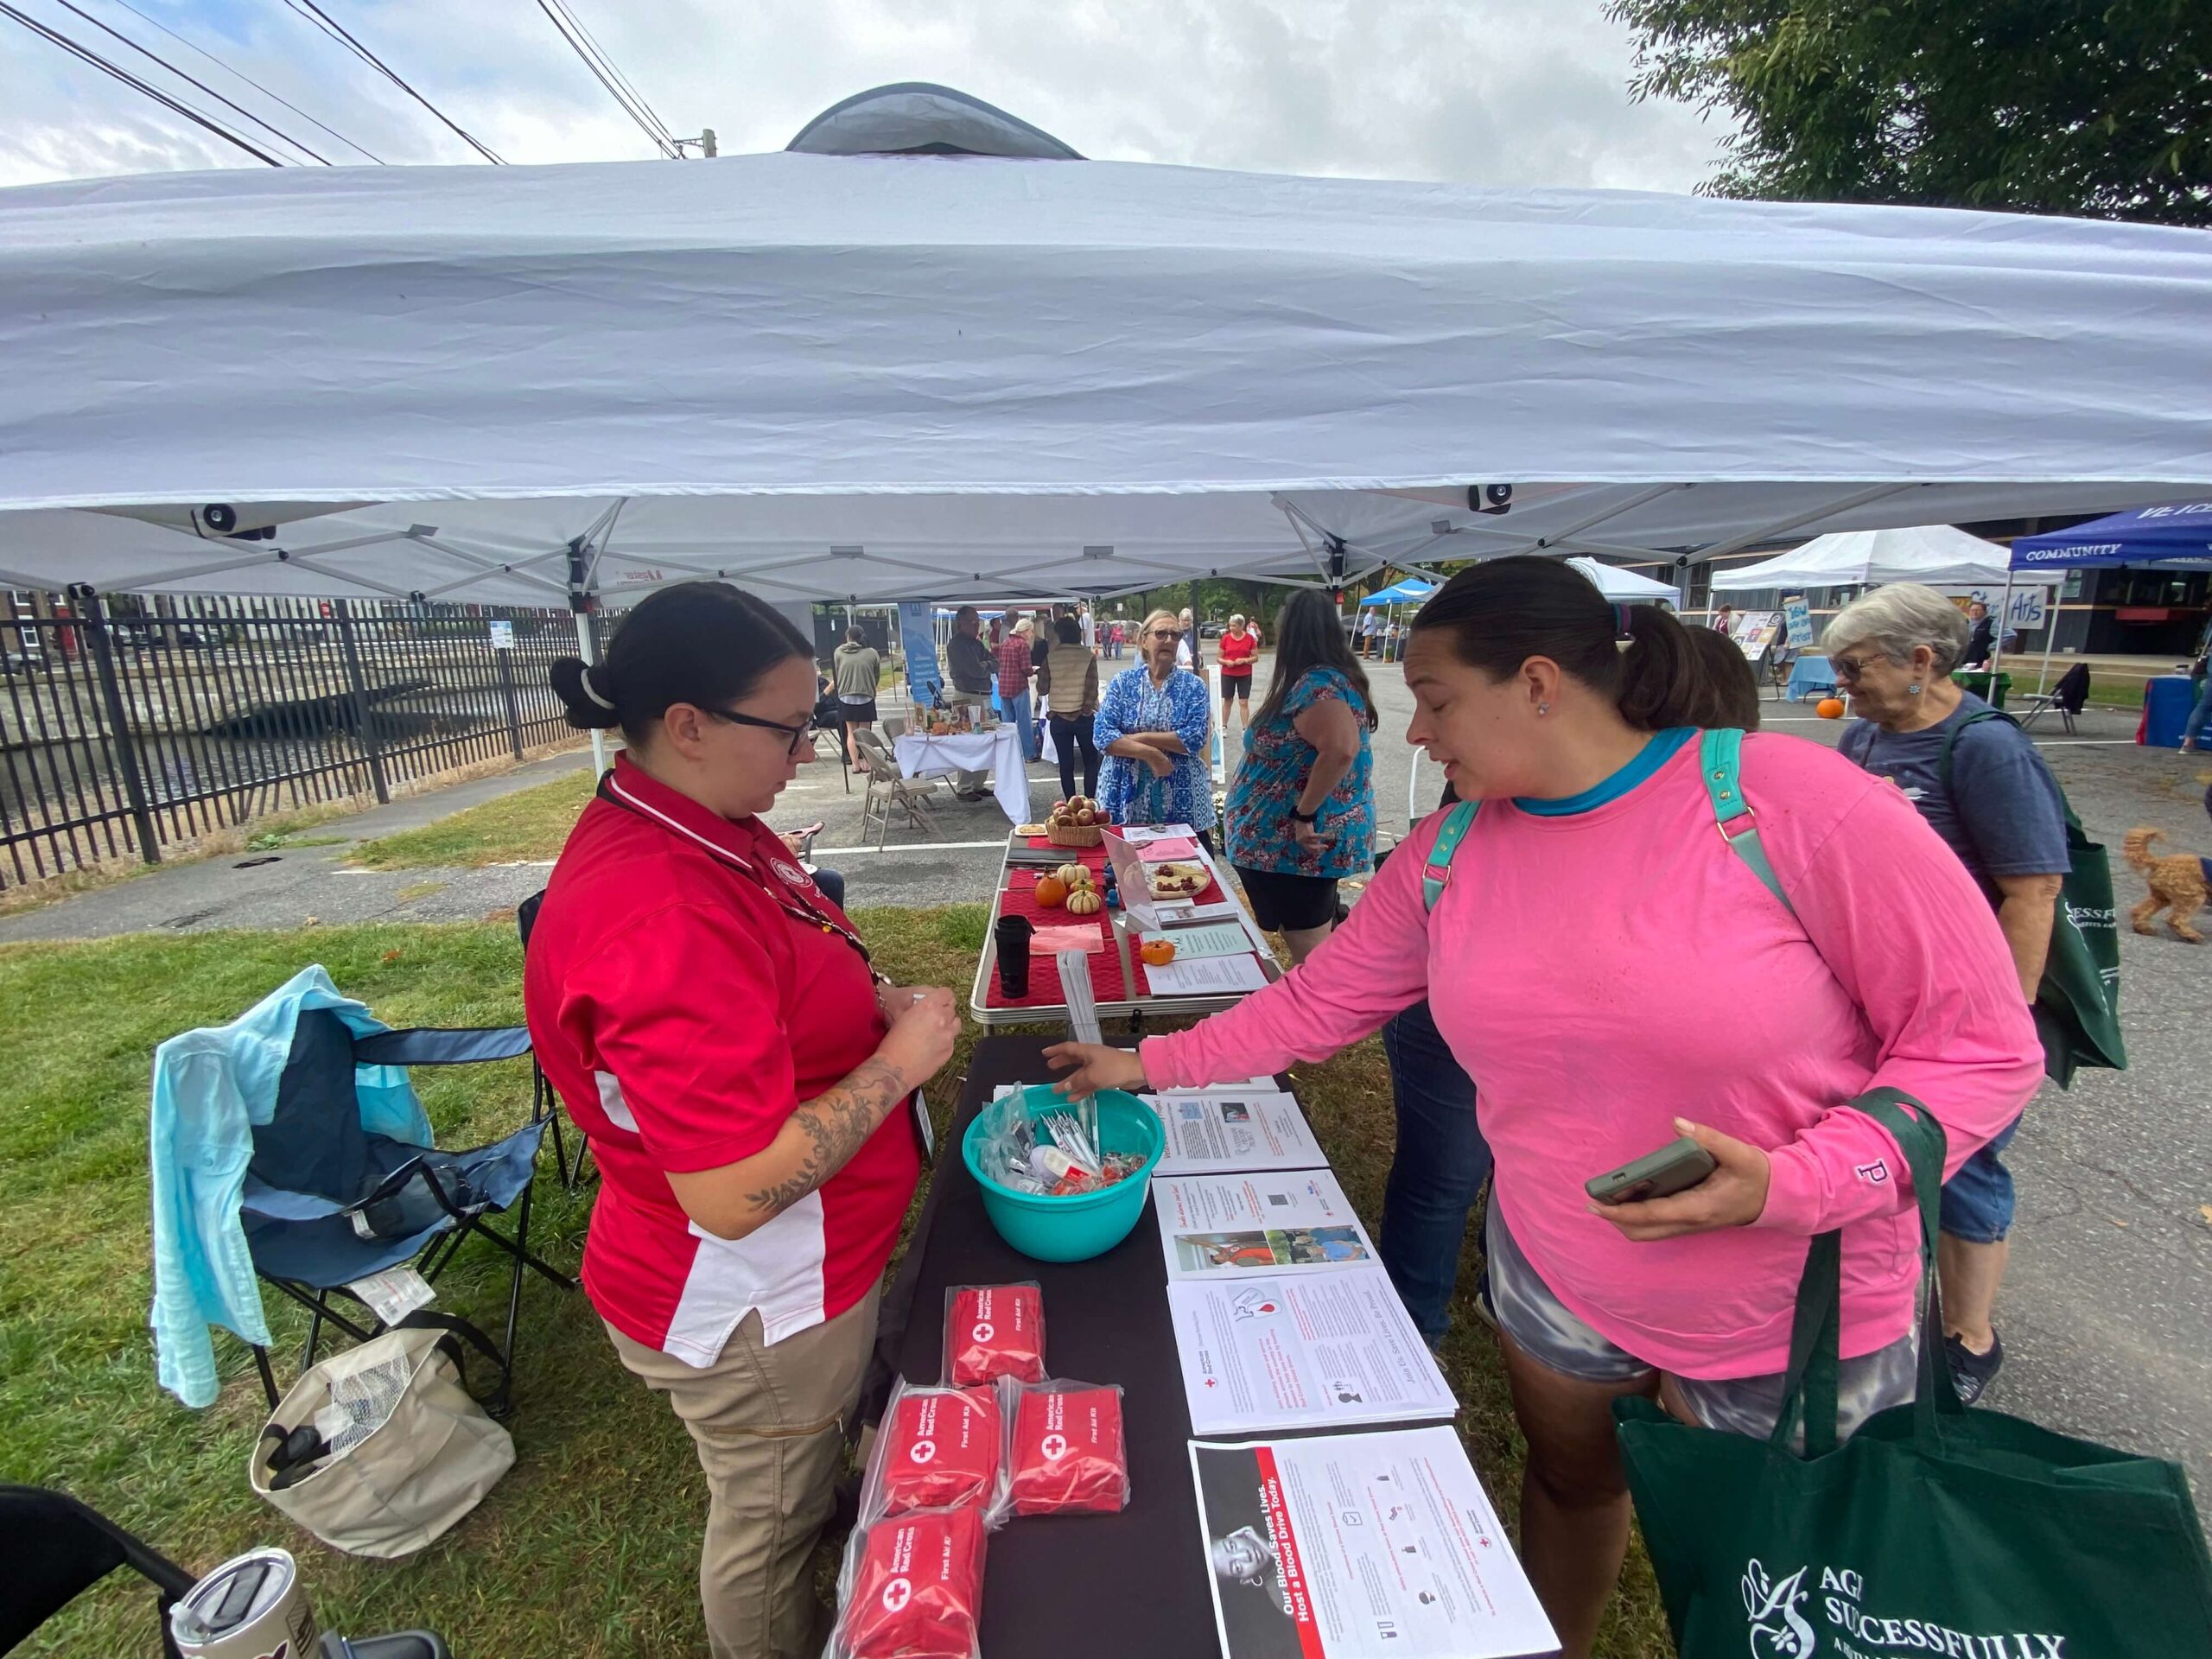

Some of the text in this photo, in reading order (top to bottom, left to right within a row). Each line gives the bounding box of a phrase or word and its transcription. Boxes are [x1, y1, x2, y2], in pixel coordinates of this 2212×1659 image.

[2026, 543, 2123, 561] COMMUNITY
[2011, 593, 2042, 622] Arts
[1856, 1158, 1889, 1185] P
[983, 1306, 992, 1320] Red
[1374, 1310, 1382, 1319] Be
[1389, 1338, 1401, 1355] Save
[1403, 1368, 1415, 1383] Join
[917, 1398, 929, 1435] American
[925, 1397, 938, 1436] Red Cross
[1046, 1395, 1054, 1430] American
[1054, 1415, 1063, 1431] Red
[960, 1431, 969, 1448] First
[890, 1528, 905, 1573] American
[899, 1526, 916, 1573] Red Cross
[942, 1546, 950, 1557] Aid
[1257, 1484, 1295, 1616] Our Blood Saves Lives.
[1268, 1477, 1309, 1622] Host a Blood Drive Today.
[941, 1559, 950, 1580] First
